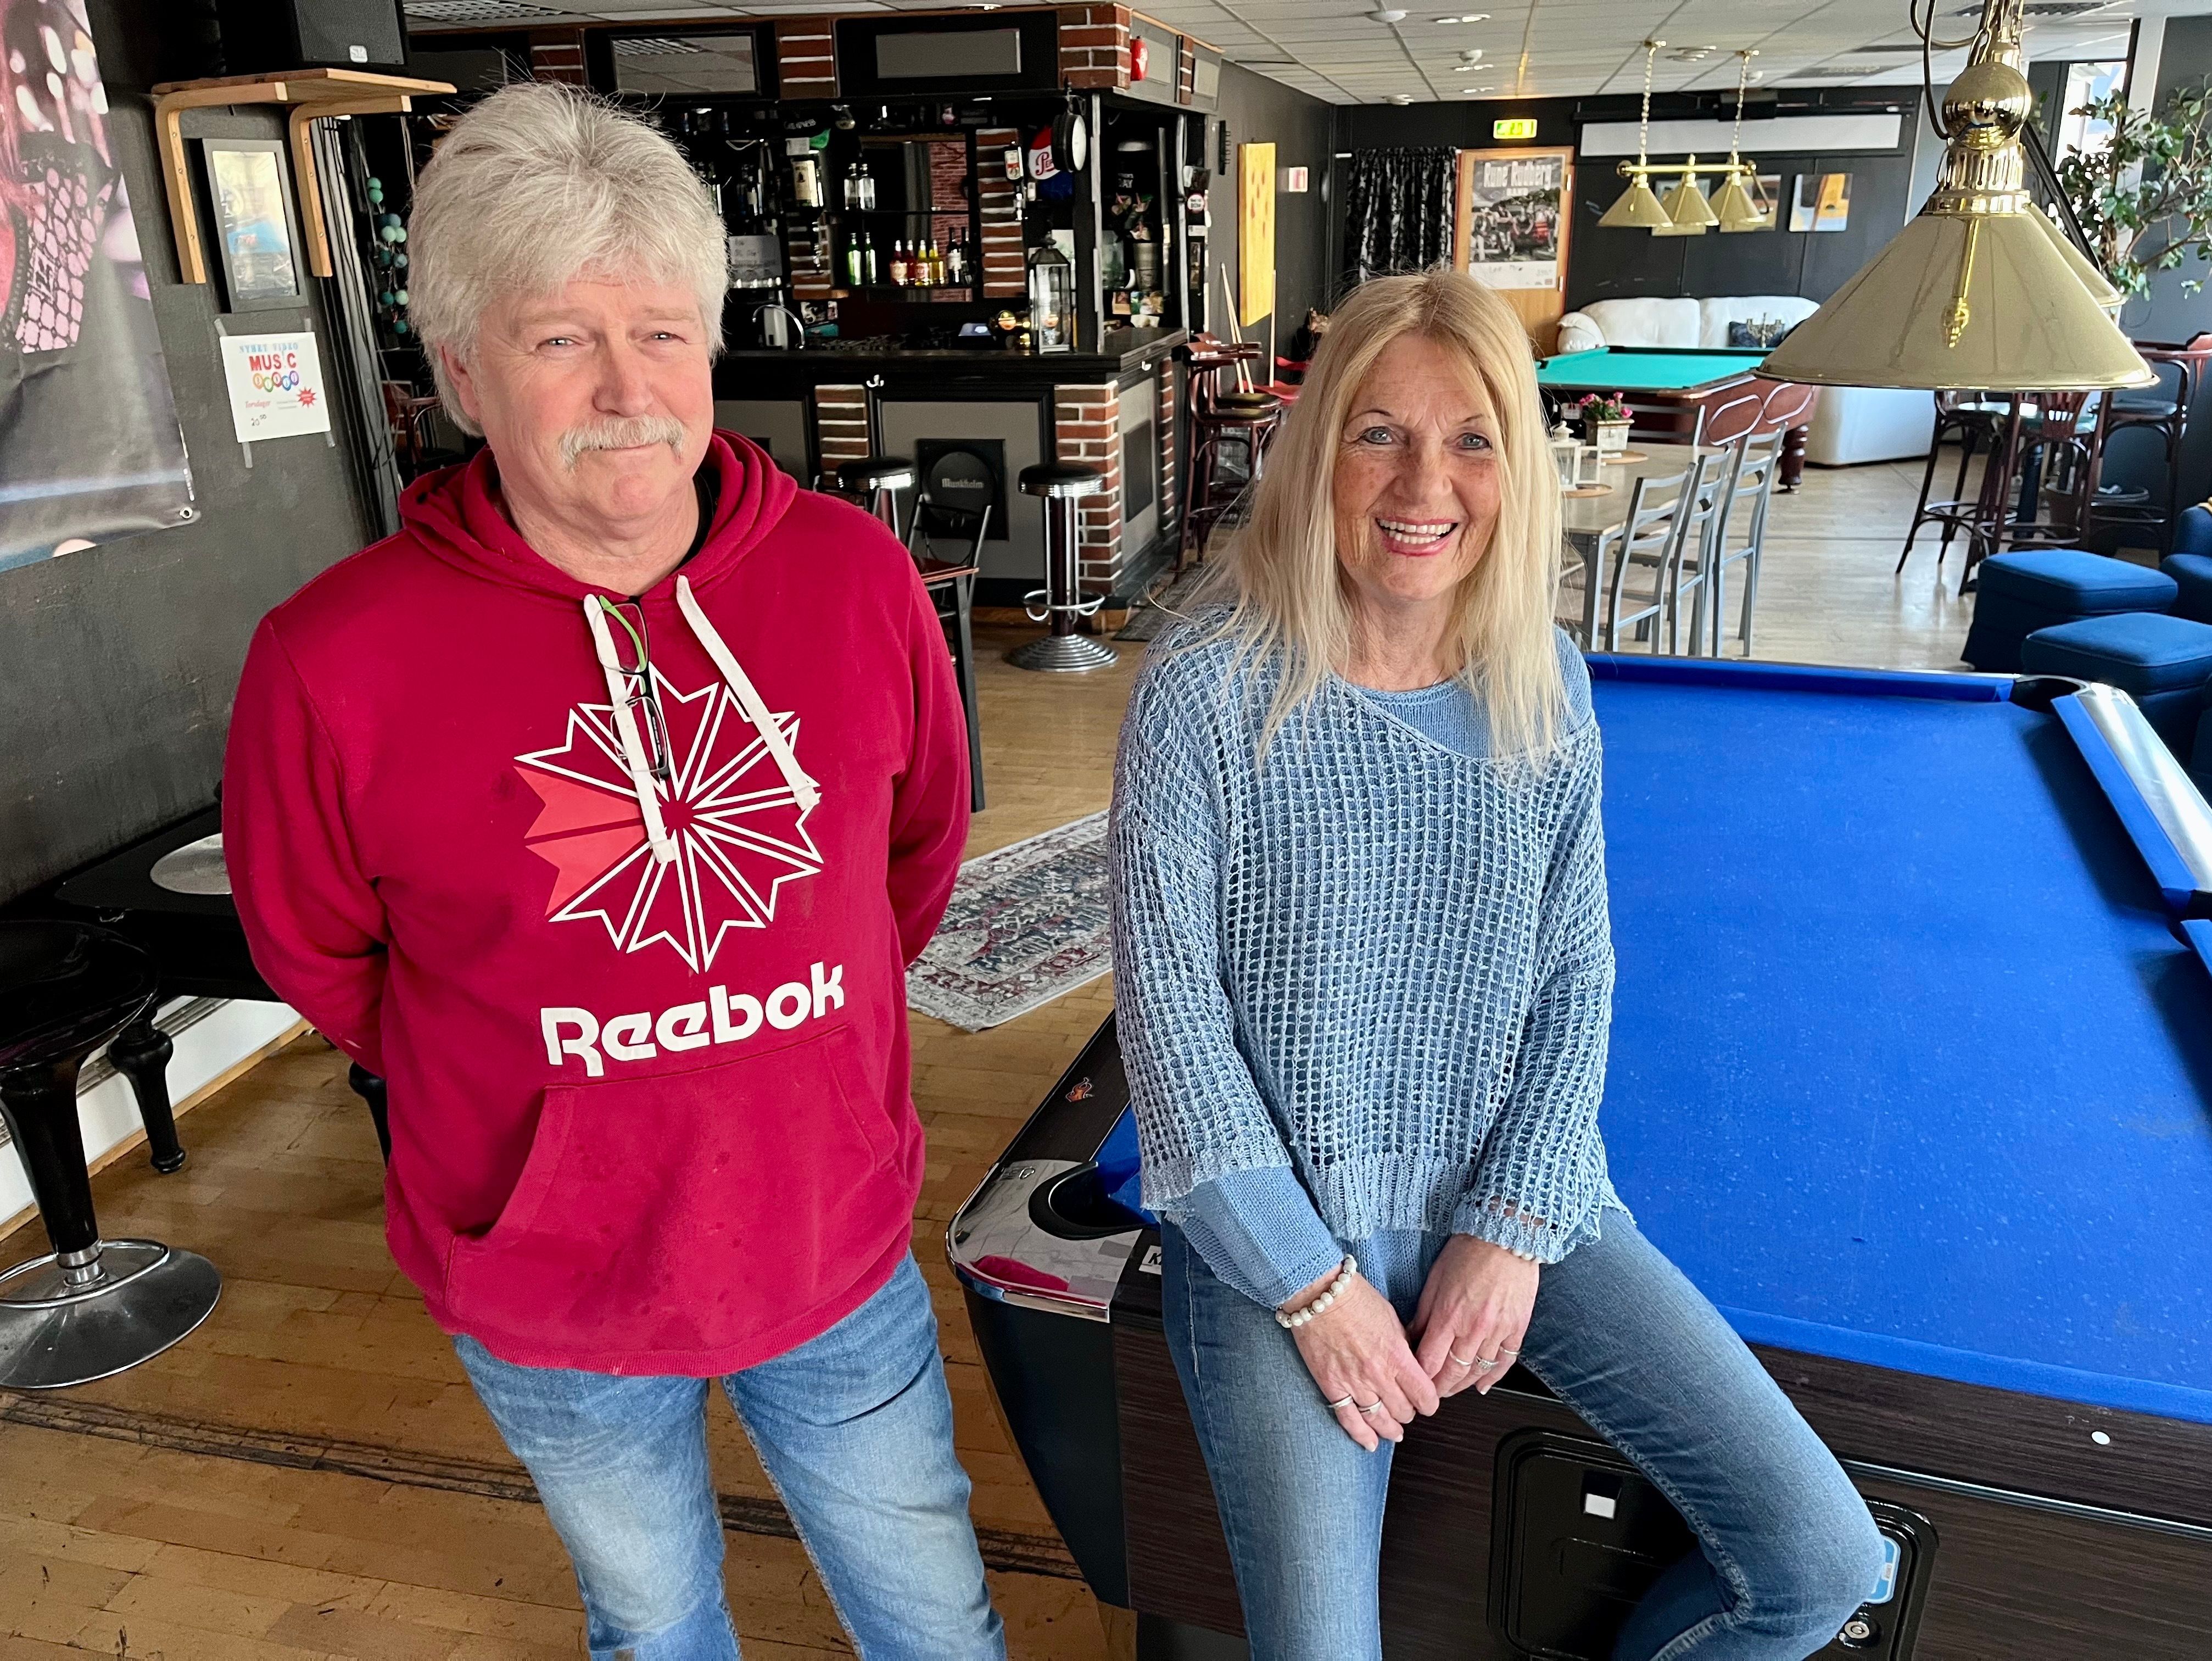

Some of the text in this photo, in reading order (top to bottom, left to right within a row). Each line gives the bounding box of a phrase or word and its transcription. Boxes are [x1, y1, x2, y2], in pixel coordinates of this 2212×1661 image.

[1484, 161, 1552, 191] Rune Rudberg
[249, 353, 297, 371] MUSC
[942, 478, 984, 488] Munkholm
[540, 961, 845, 1077] Reebok
